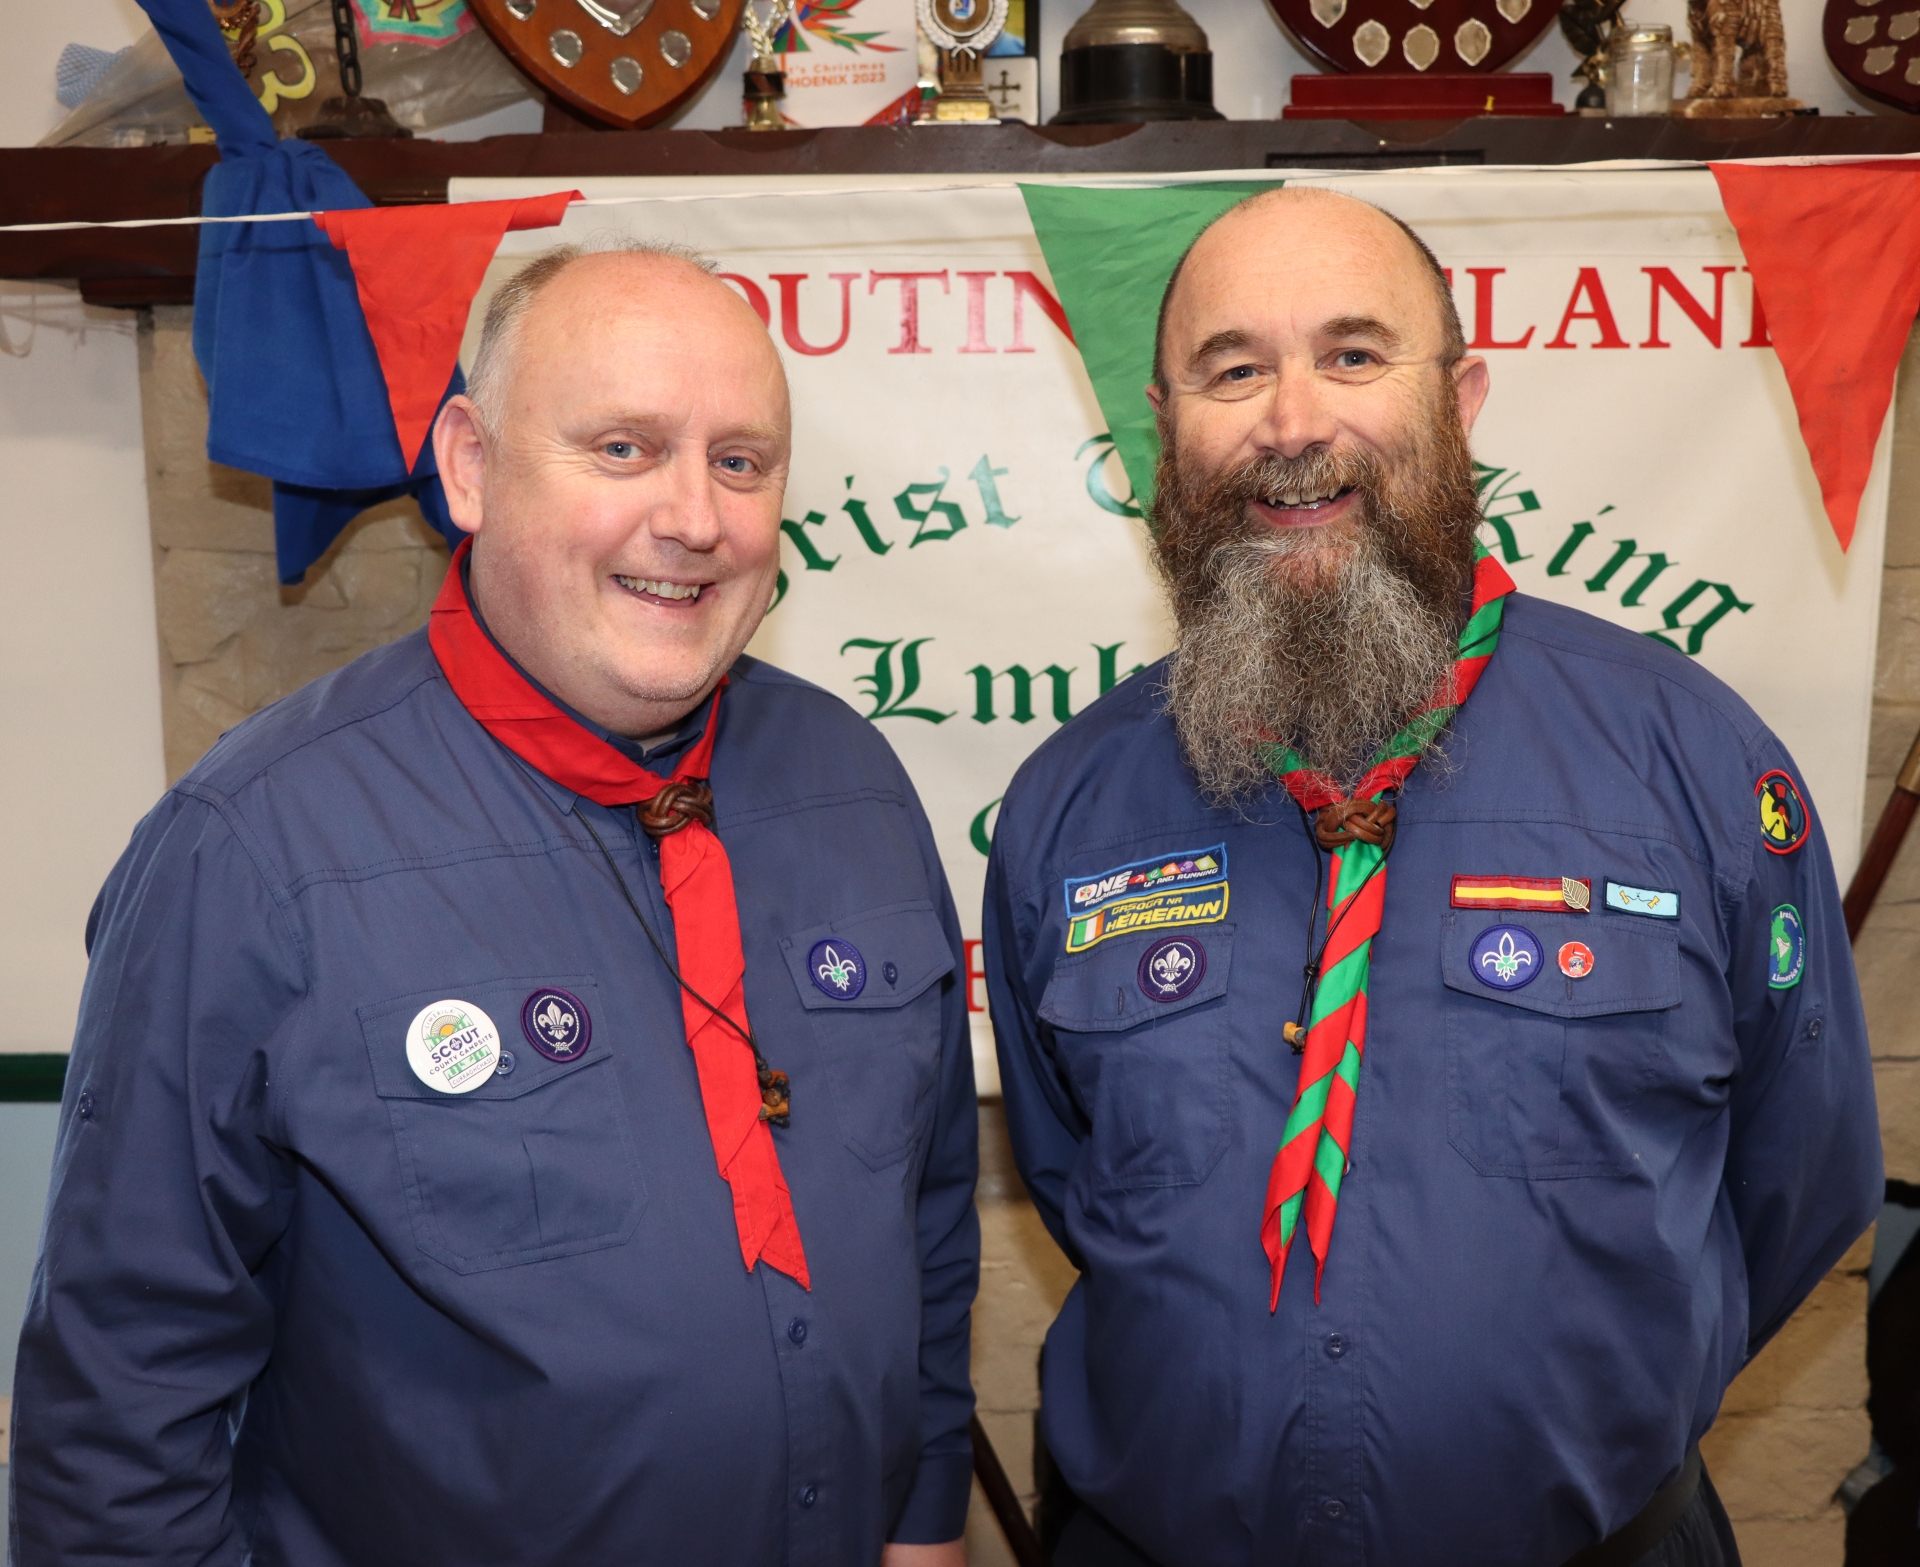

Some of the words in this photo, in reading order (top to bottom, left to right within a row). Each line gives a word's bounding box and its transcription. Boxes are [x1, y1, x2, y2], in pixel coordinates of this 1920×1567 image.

[852, 71, 886, 85] 2023
[1442, 265, 1773, 349] LAN
[766, 453, 1022, 616] rist
[1074, 870, 1133, 903] ONE
[1156, 875, 1175, 885] AND
[1177, 867, 1219, 880] RUNNING
[1166, 896, 1183, 905] NA
[1771, 967, 1799, 983] Limerick
[429, 1054, 458, 1076] COUNTY
[459, 1032, 494, 1057] CAMPSITE
[431, 1027, 481, 1064] SCOUT
[452, 1056, 494, 1086] CURRAGHCHASE
